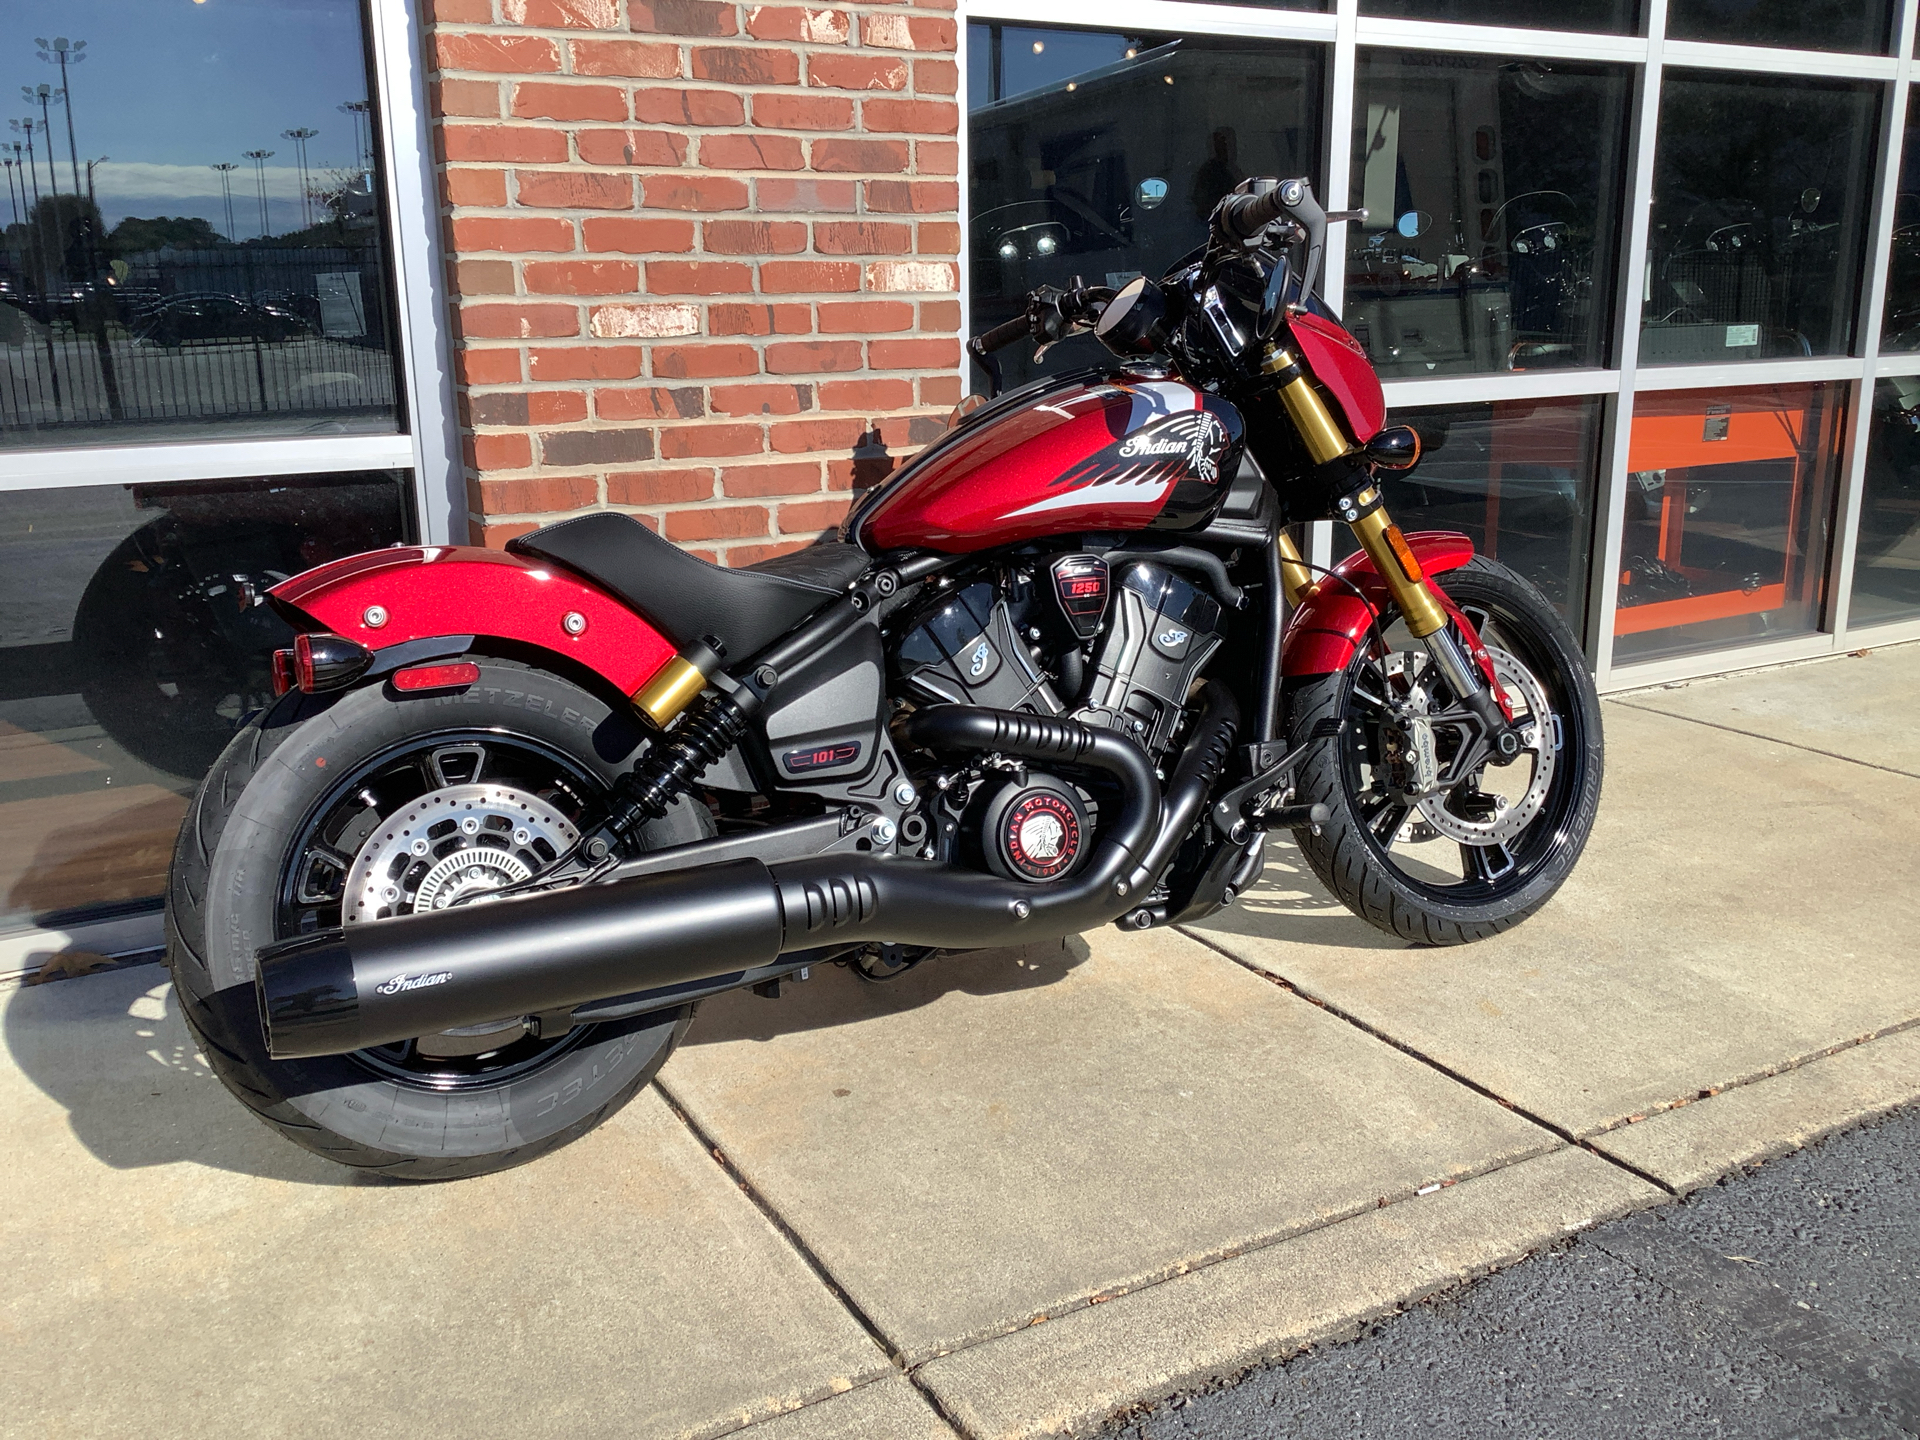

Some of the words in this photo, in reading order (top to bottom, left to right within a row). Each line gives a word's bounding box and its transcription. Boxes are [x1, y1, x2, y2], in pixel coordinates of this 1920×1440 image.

[1119, 434, 1188, 458] Indian
[1071, 582, 1100, 594] 1250
[1433, 571, 1495, 587] ETZELER
[434, 686, 599, 738] METZELER
[812, 750, 834, 764] 101
[1421, 733, 1433, 777] brembo
[1555, 751, 1599, 872] CRUISETEC
[1010, 812, 1026, 865] INDIAN
[1024, 797, 1079, 856] MOTORCYCLE
[1036, 864, 1062, 876] 1901
[383, 972, 447, 994] Indian
